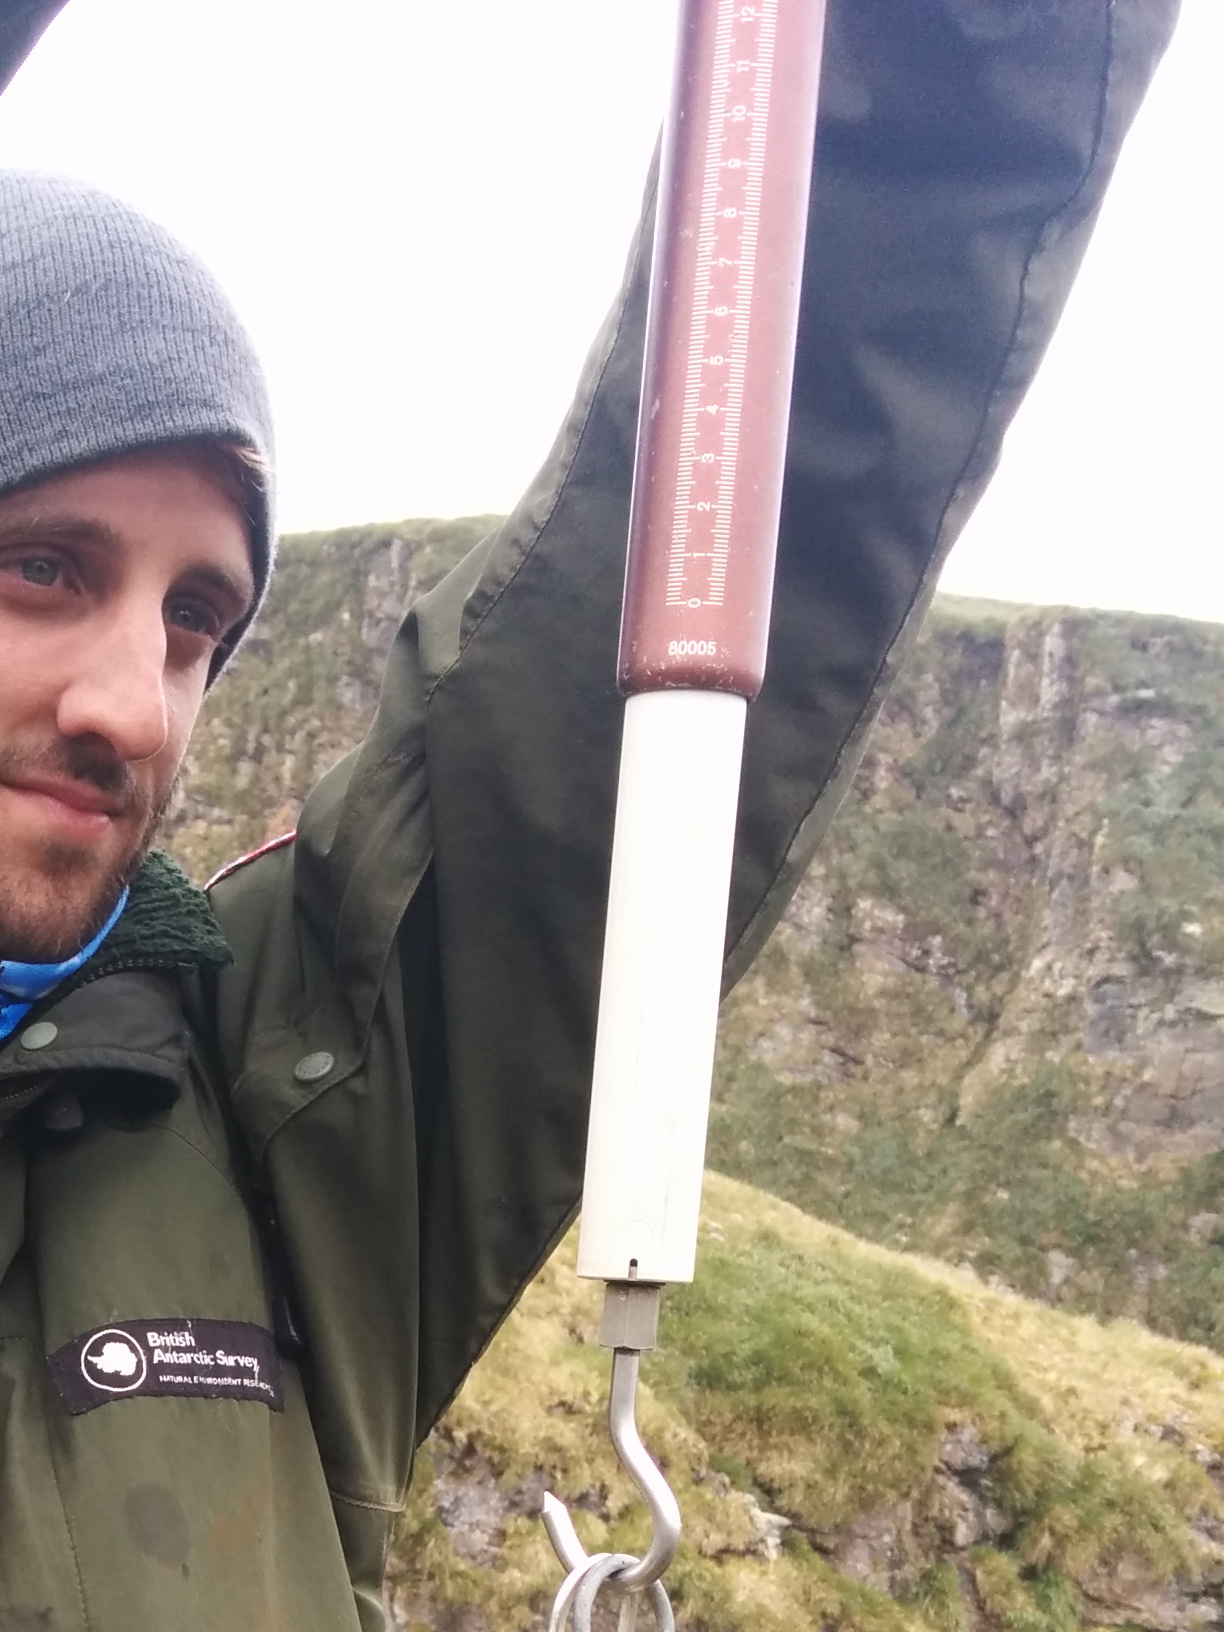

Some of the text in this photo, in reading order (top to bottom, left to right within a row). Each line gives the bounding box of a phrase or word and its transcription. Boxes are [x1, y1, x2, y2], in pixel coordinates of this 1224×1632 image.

[740, 5, 756, 23] 12
[736, 59, 751, 72] 11
[732, 104, 747, 122] 10
[727, 157, 742, 169] 9
[723, 207, 738, 219] 8
[718, 256, 733, 267] 7
[714, 305, 729, 317] 6
[709, 354, 724, 366] 5
[705, 403, 719, 415] 4
[701, 452, 715, 464] 3
[696, 501, 711, 512] 2
[687, 597, 702, 609] 0
[668, 640, 716, 656] 80005
[147, 1331, 195, 1347] British
[153, 1349, 259, 1372] Antarctic Survey
[159, 1375, 192, 1384] NATURAL
